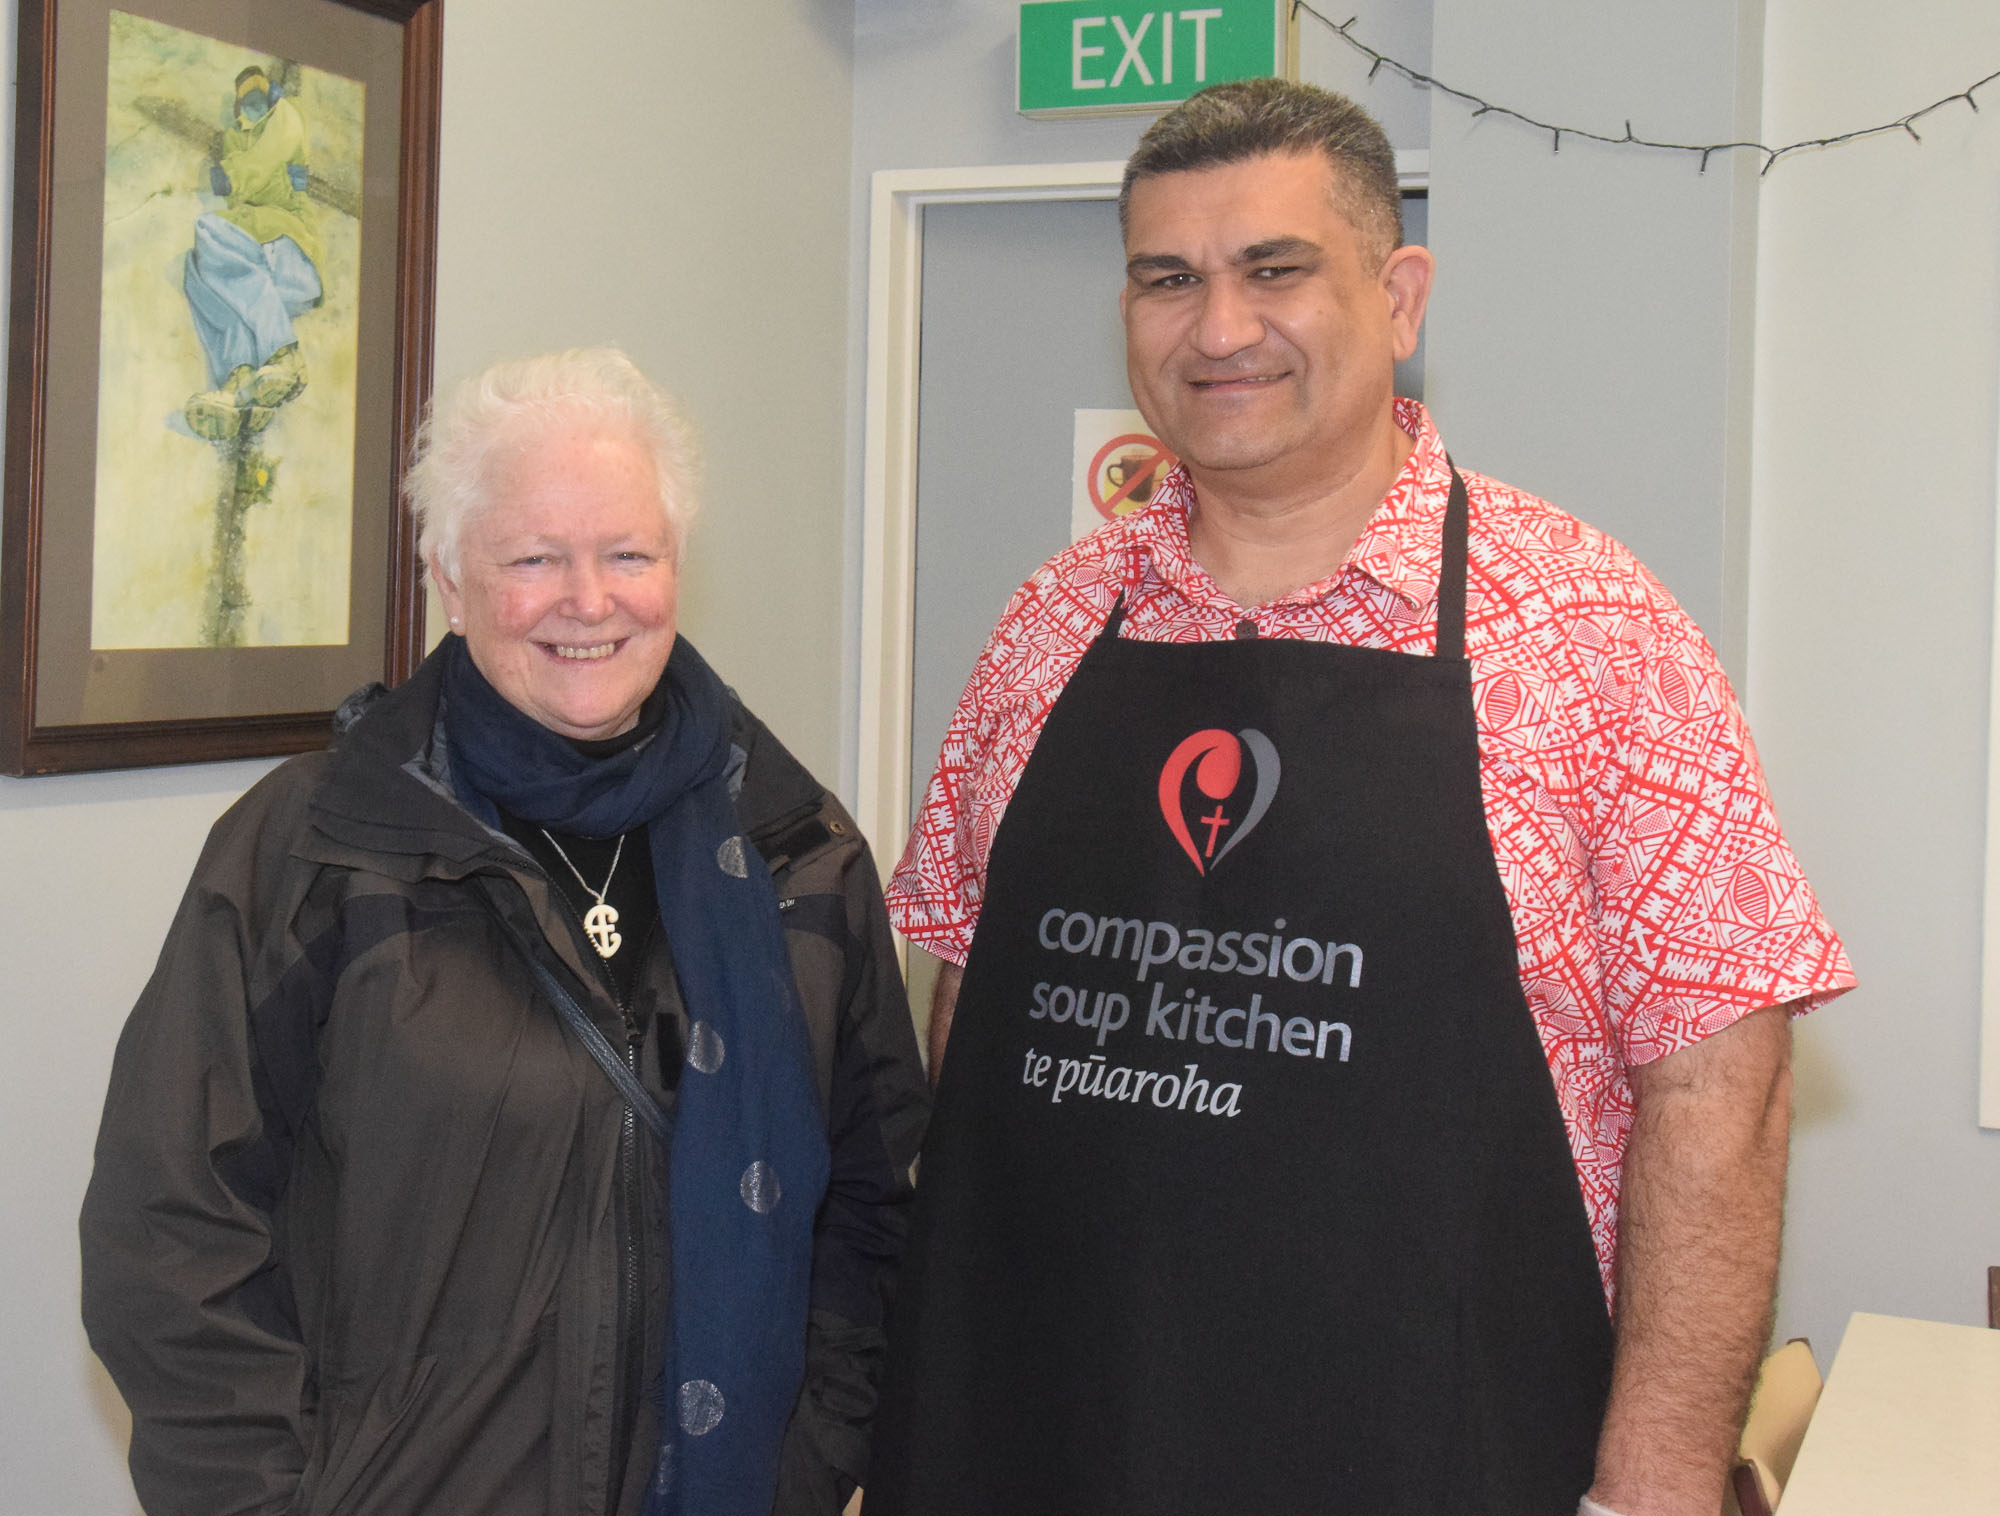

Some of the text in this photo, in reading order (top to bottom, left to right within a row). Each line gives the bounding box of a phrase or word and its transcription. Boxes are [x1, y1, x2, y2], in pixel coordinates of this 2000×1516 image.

[1072, 9, 1222, 90] EXIT
[1039, 908, 1363, 988] compassion
[1029, 982, 1352, 1062] soup kitchen
[1023, 1048, 1243, 1118] te pūaroha
